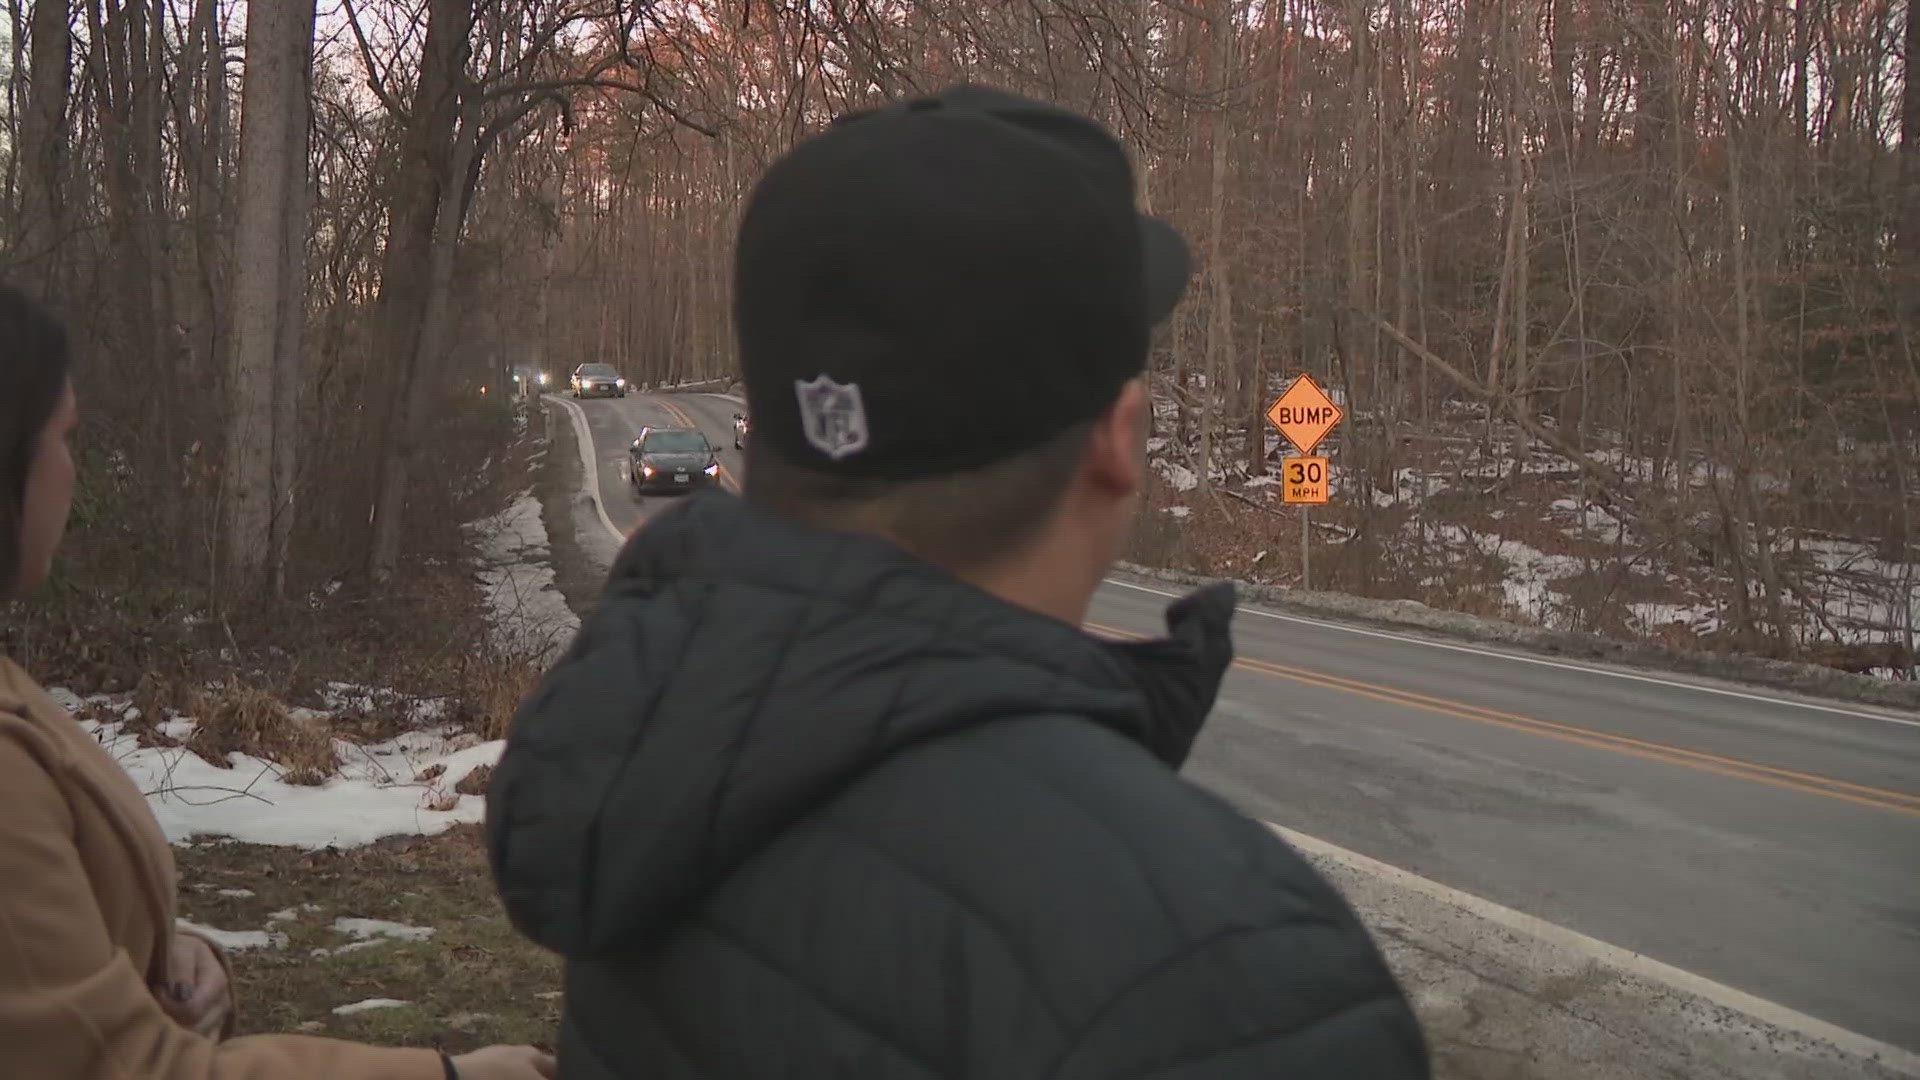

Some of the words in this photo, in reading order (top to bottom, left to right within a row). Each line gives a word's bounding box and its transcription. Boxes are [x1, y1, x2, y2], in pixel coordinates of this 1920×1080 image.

[1279, 407, 1333, 425] BUMP
[1290, 463, 1322, 484] 30
[1292, 488, 1319, 498] MPH
